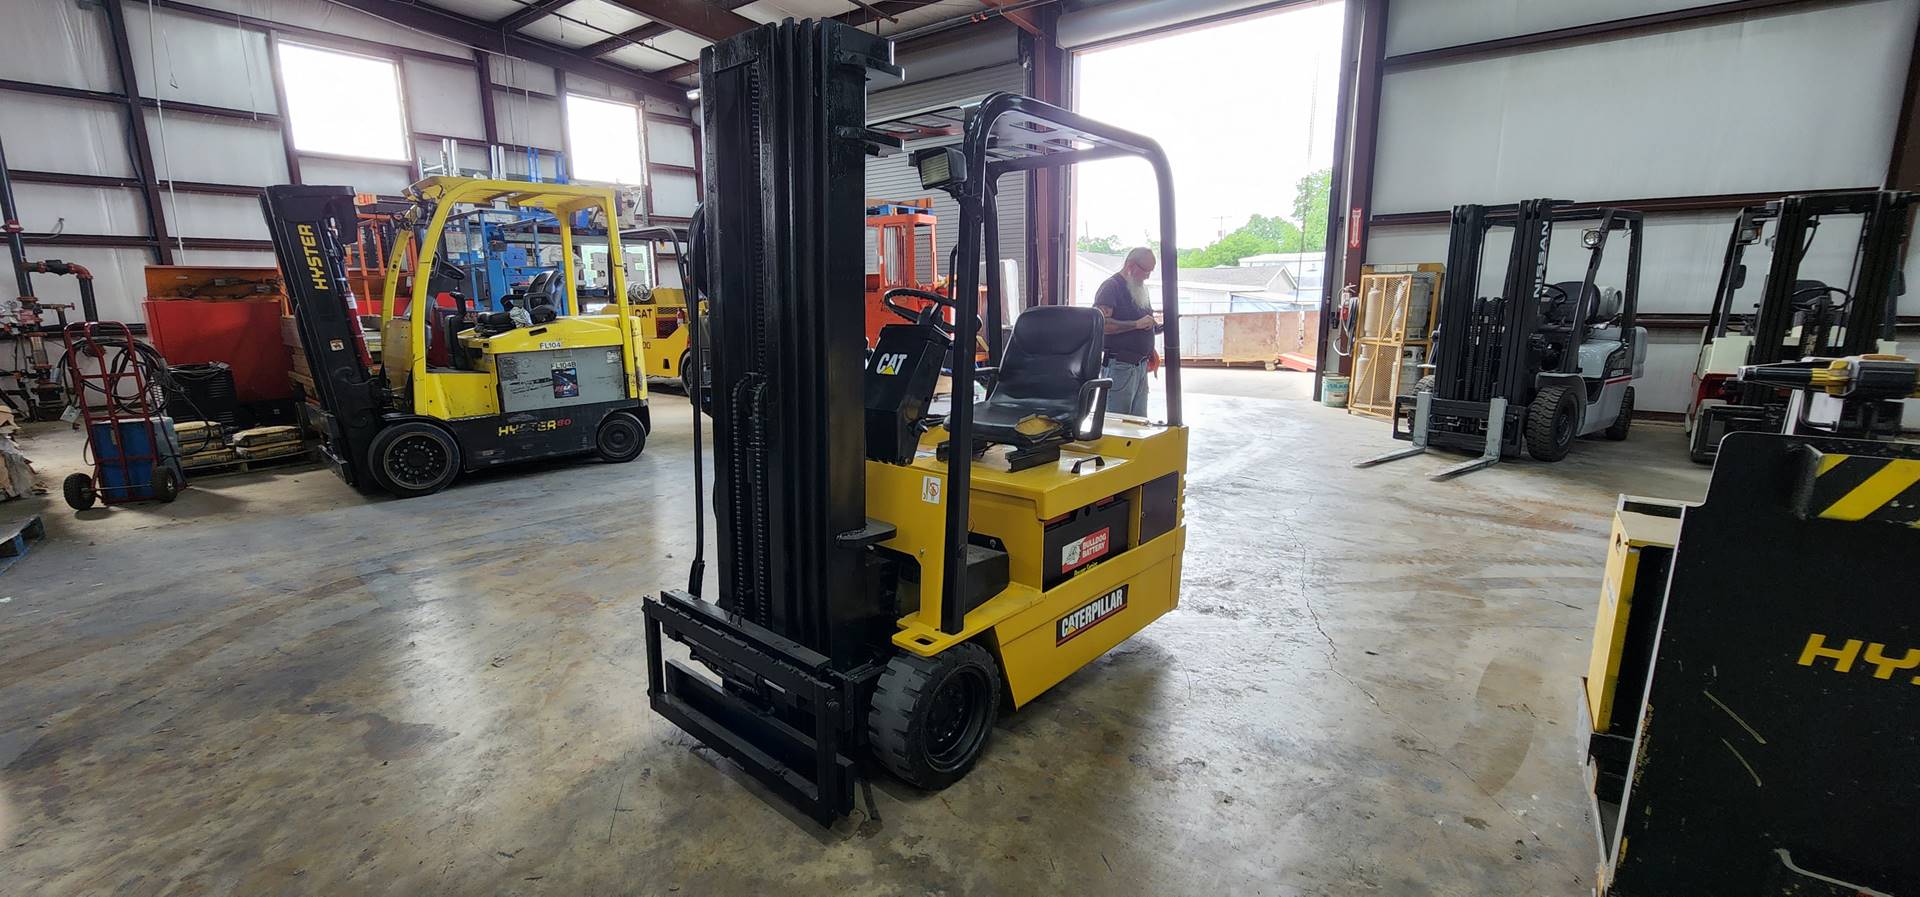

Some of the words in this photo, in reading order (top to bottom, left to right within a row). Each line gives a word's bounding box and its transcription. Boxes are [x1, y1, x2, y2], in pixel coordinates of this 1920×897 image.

[297, 224, 328, 290] HYSTER
[1533, 221, 1549, 298] NISSAN
[634, 308, 653, 318] CAT
[876, 353, 907, 375] CAT
[1082, 533, 1106, 550] BULLDOG
[1082, 542, 1105, 558] BATTERY
[1061, 589, 1123, 637] CATERPILLAR
[1797, 633, 1920, 686] HY
